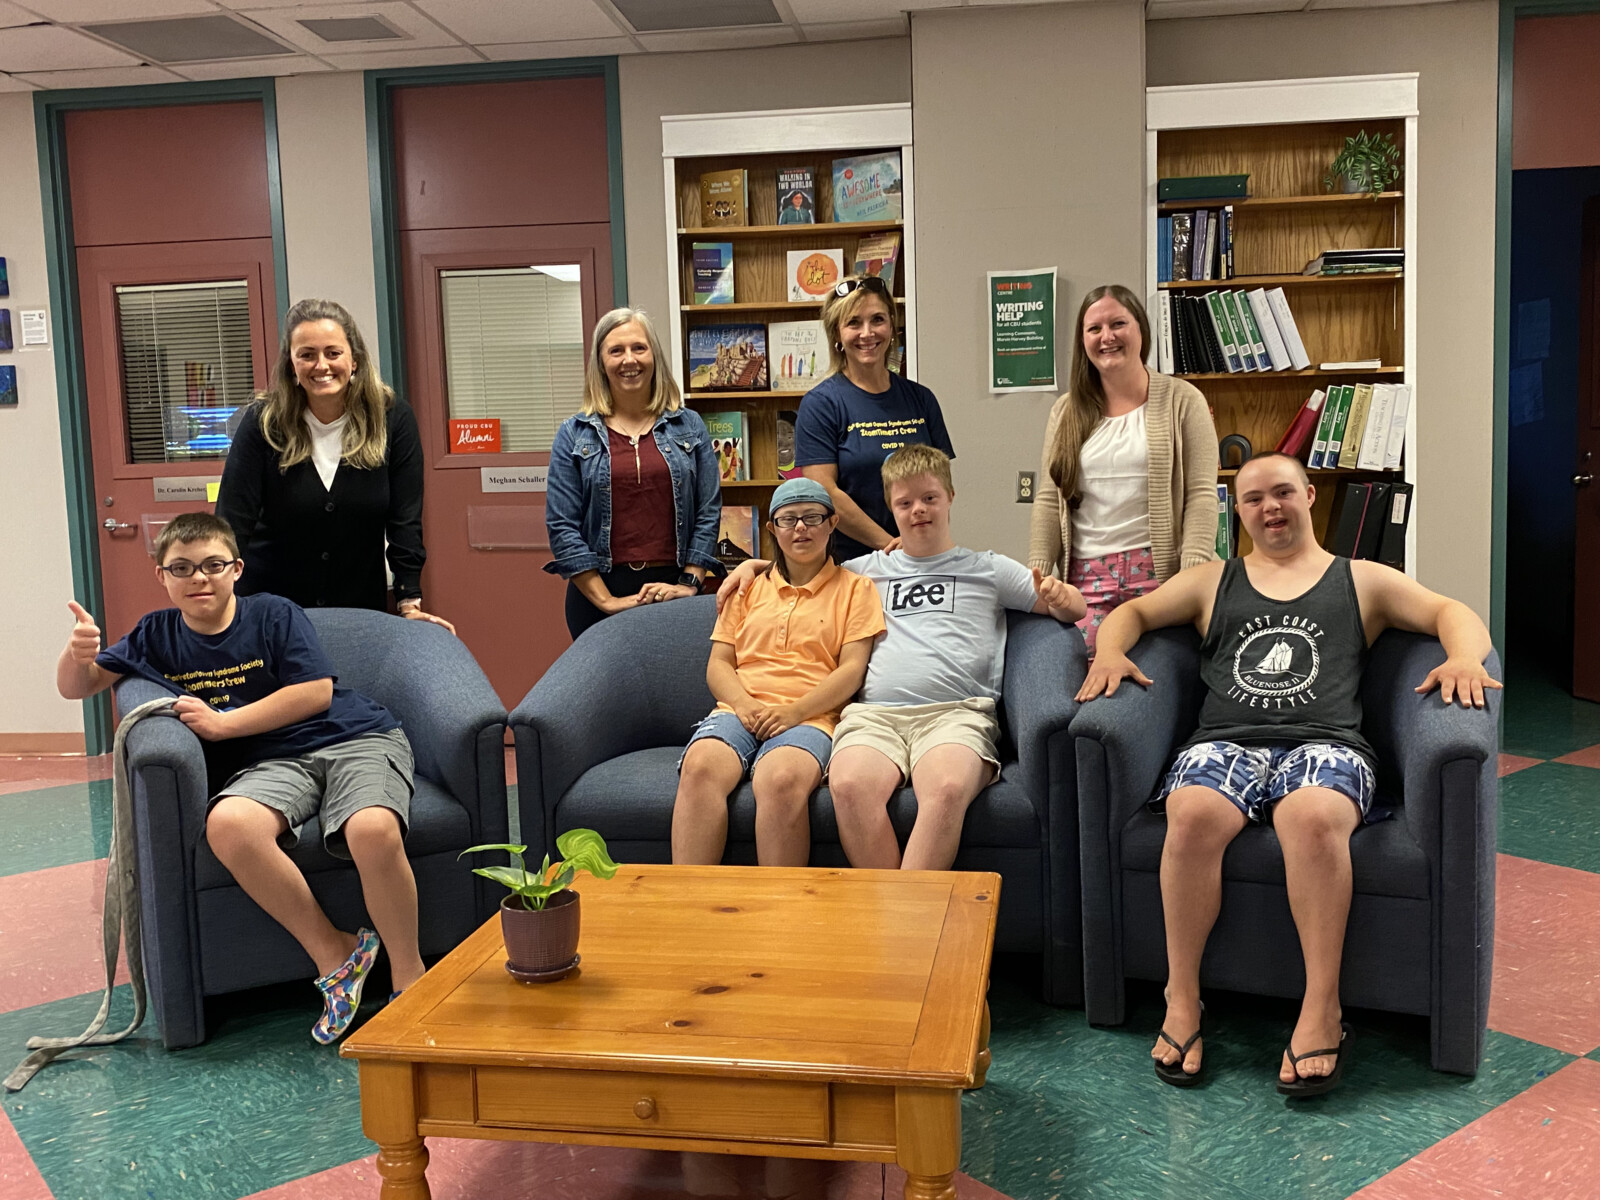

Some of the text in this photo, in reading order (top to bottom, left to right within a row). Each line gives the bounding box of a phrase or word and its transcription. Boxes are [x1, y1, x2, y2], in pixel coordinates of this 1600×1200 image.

[841, 172, 881, 200] AWESOME
[807, 271, 830, 286] dot
[996, 301, 1044, 312] WRITING
[996, 311, 1024, 321] HELP
[708, 420, 734, 433] Trees
[457, 429, 495, 446] Alumni
[489, 477, 517, 485] Meghan
[891, 583, 945, 611] Lee
[1238, 615, 1325, 638] EAST COAST
[239, 658, 264, 671] Society
[225, 675, 246, 687] Crew
[1244, 674, 1292, 689] BLUENOSE
[1227, 685, 1317, 709] LIFESTYLE
